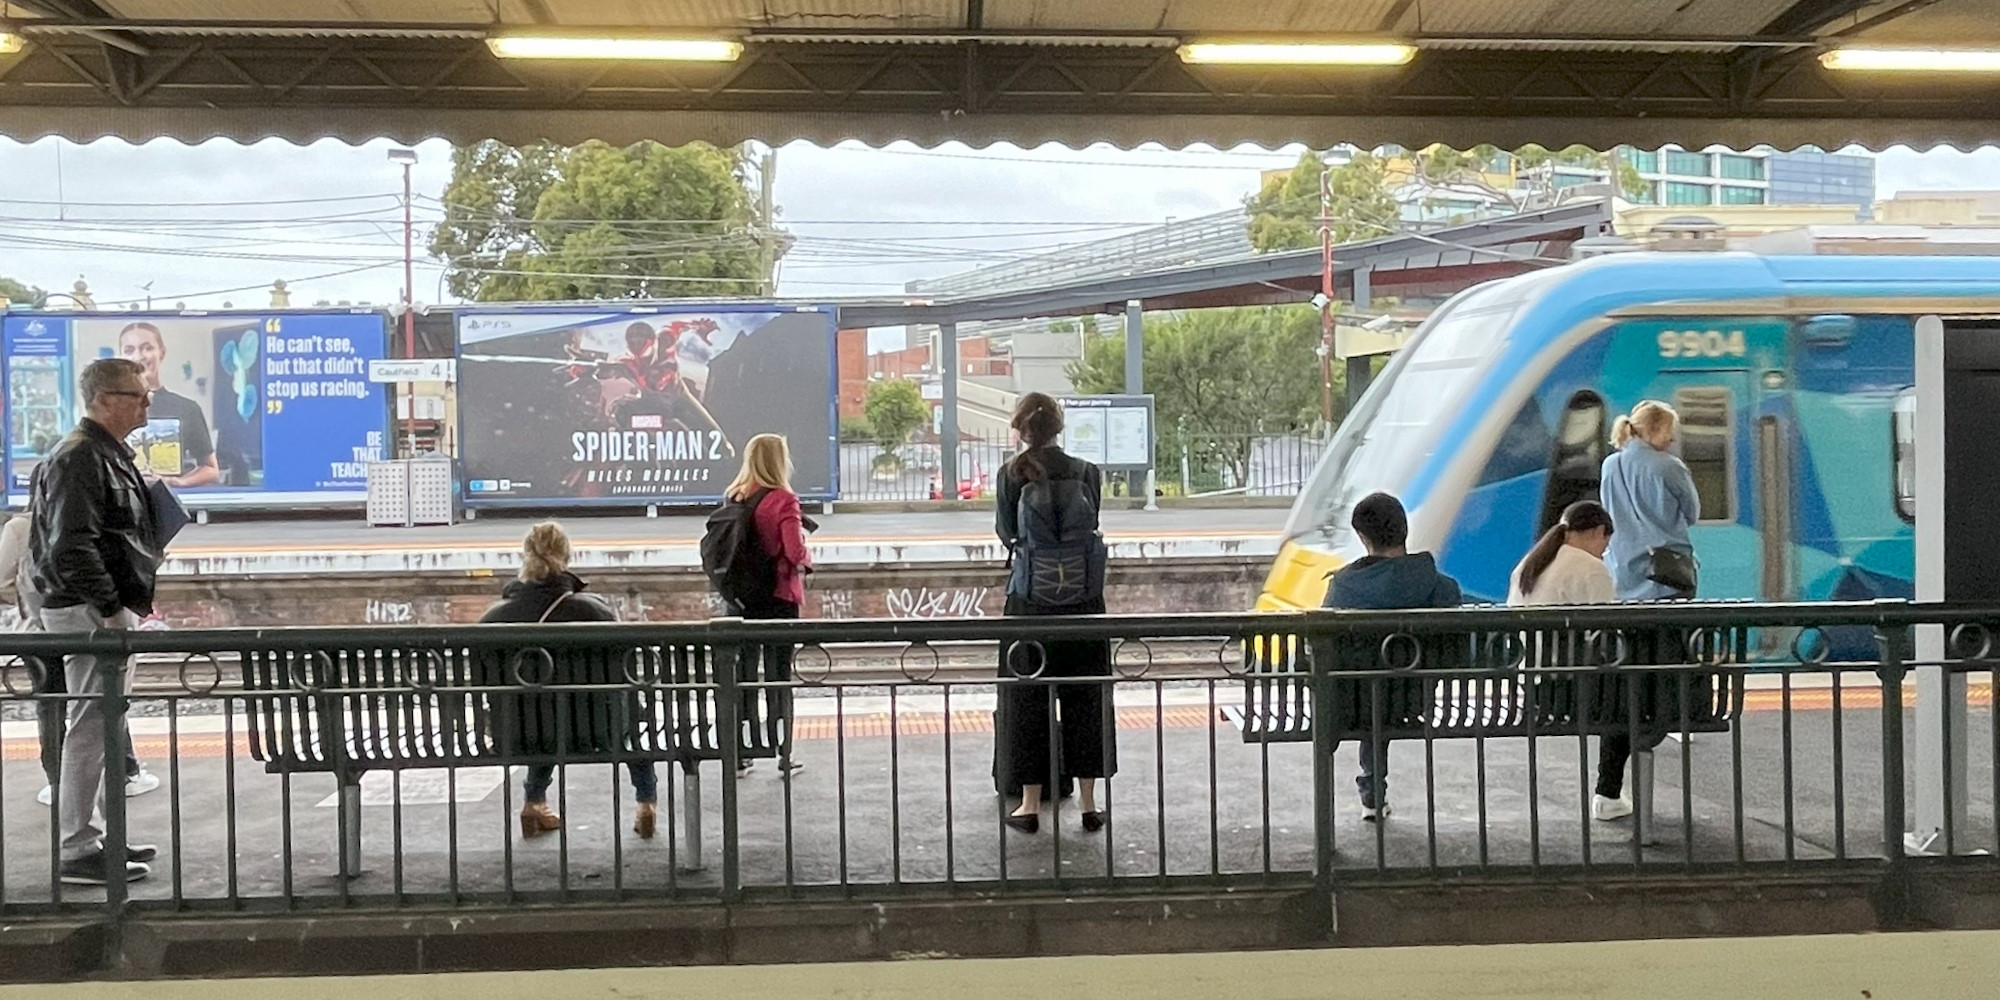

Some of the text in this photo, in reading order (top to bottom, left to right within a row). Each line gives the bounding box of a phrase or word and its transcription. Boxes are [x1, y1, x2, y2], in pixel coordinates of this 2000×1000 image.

[266, 335, 355, 354] He can't see,
[1658, 330, 1745, 358] 9904
[267, 357, 364, 375] but that didn't
[377, 363, 440, 377] Caulfield 4
[267, 379, 370, 399] stop us racing.
[366, 430, 382, 447] BE
[571, 430, 722, 462] SPIDER-MAN 2
[352, 446, 382, 462] THAT
[330, 462, 369, 478] TEACH
